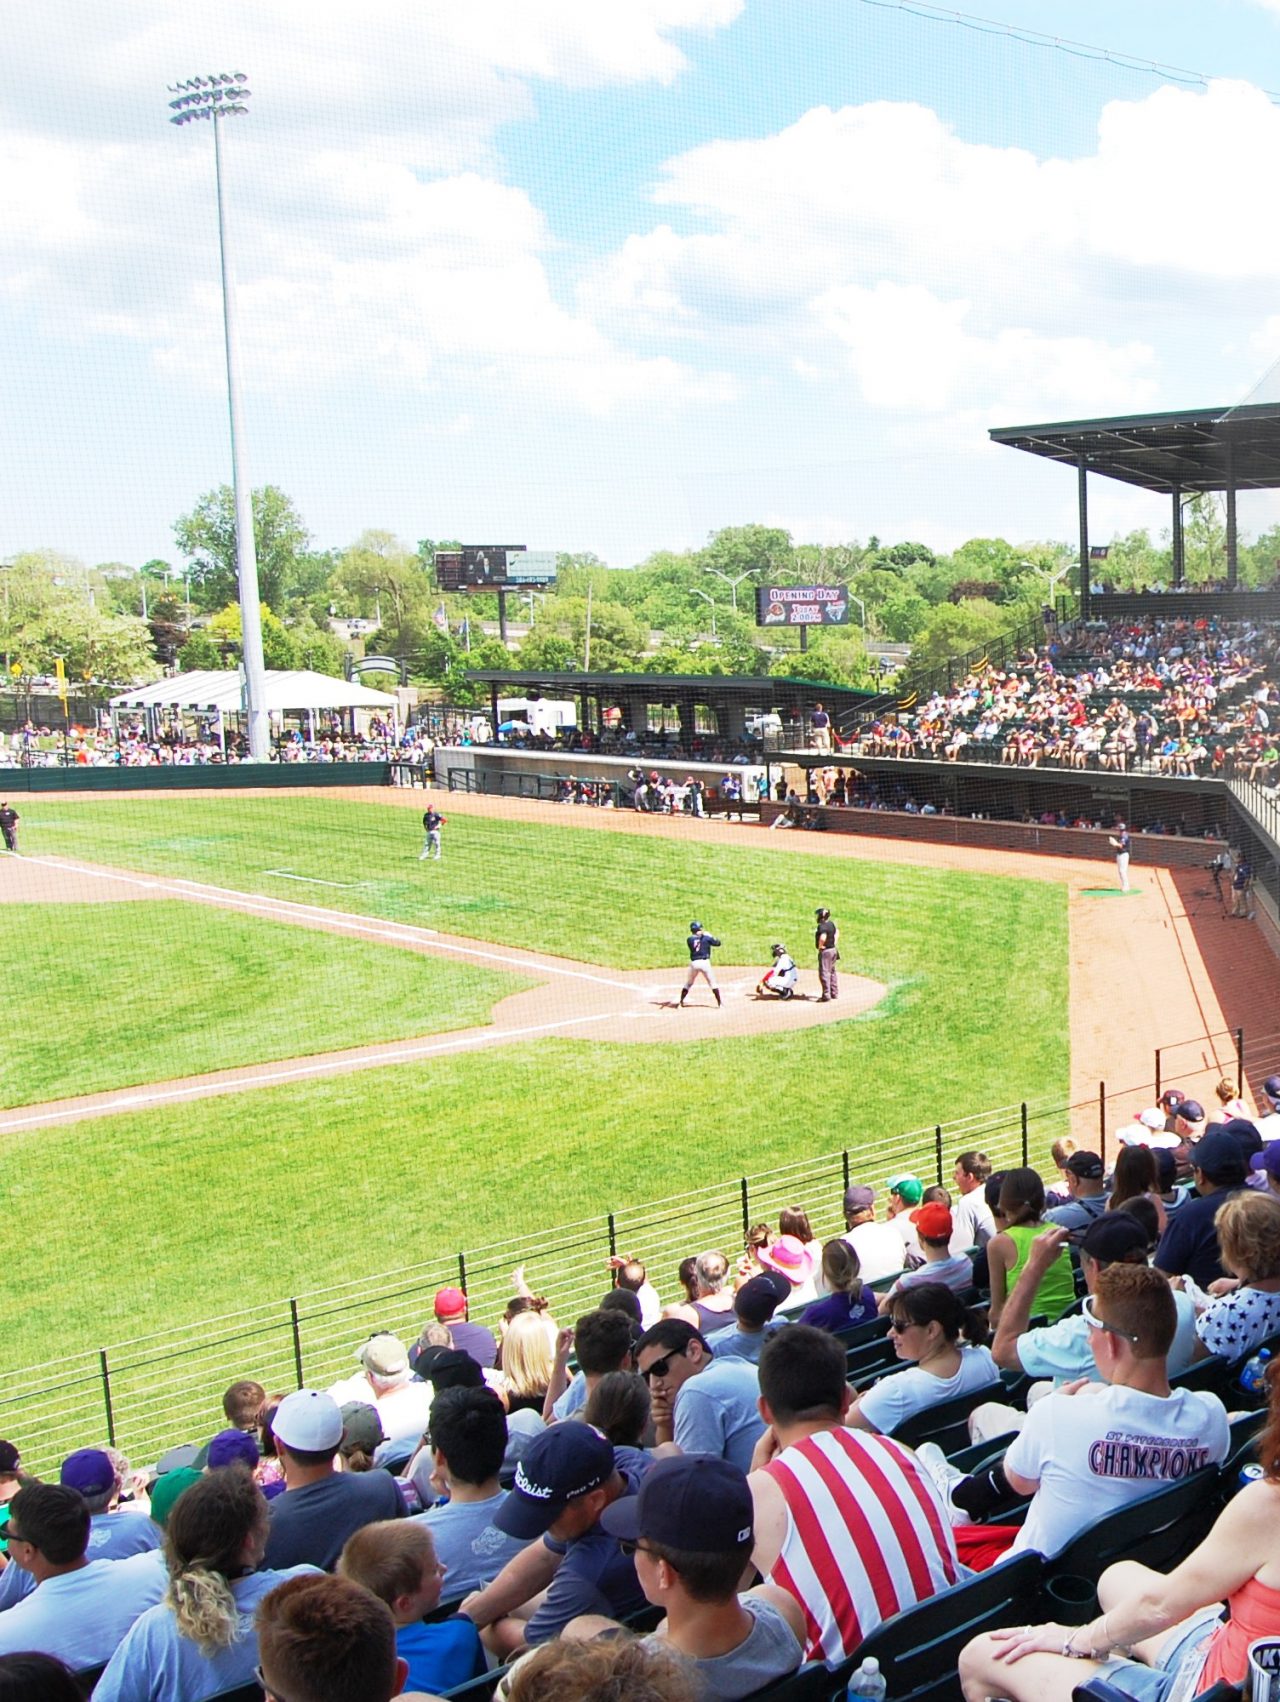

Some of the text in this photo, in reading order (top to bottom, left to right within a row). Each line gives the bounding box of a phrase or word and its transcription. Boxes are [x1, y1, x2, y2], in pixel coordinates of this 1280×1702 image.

[770, 588, 840, 601] OPENING DAY
[791, 604, 821, 614] TODAY
